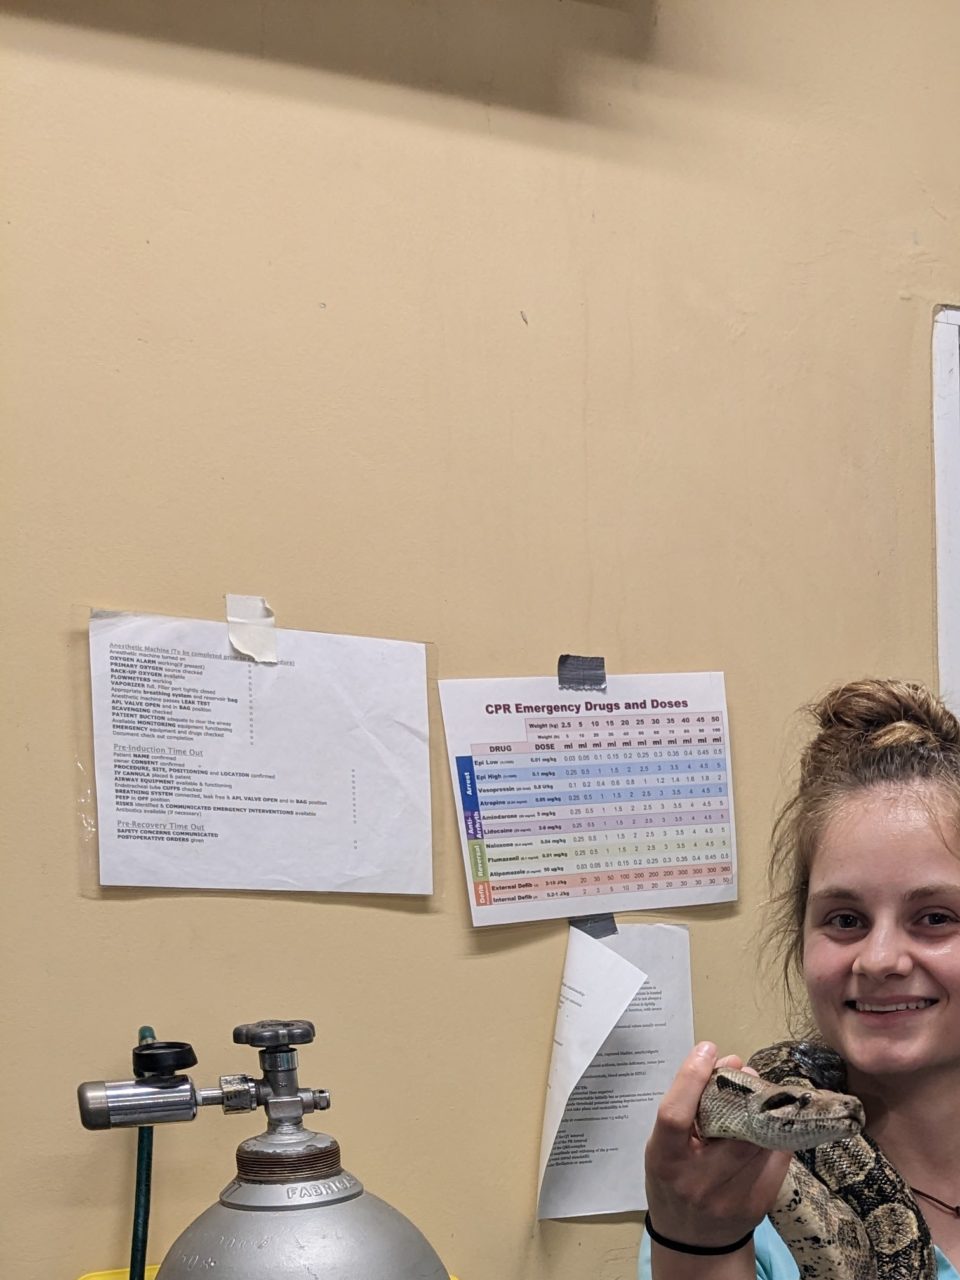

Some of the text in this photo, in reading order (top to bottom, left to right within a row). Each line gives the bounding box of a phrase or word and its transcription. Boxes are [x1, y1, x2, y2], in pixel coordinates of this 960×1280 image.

[485, 699, 689, 715] CPR Emergency Drugs and Doses
[114, 744, 203, 757] Pre-Induction Time Out
[117, 820, 167, 830] Pre-Recovery
